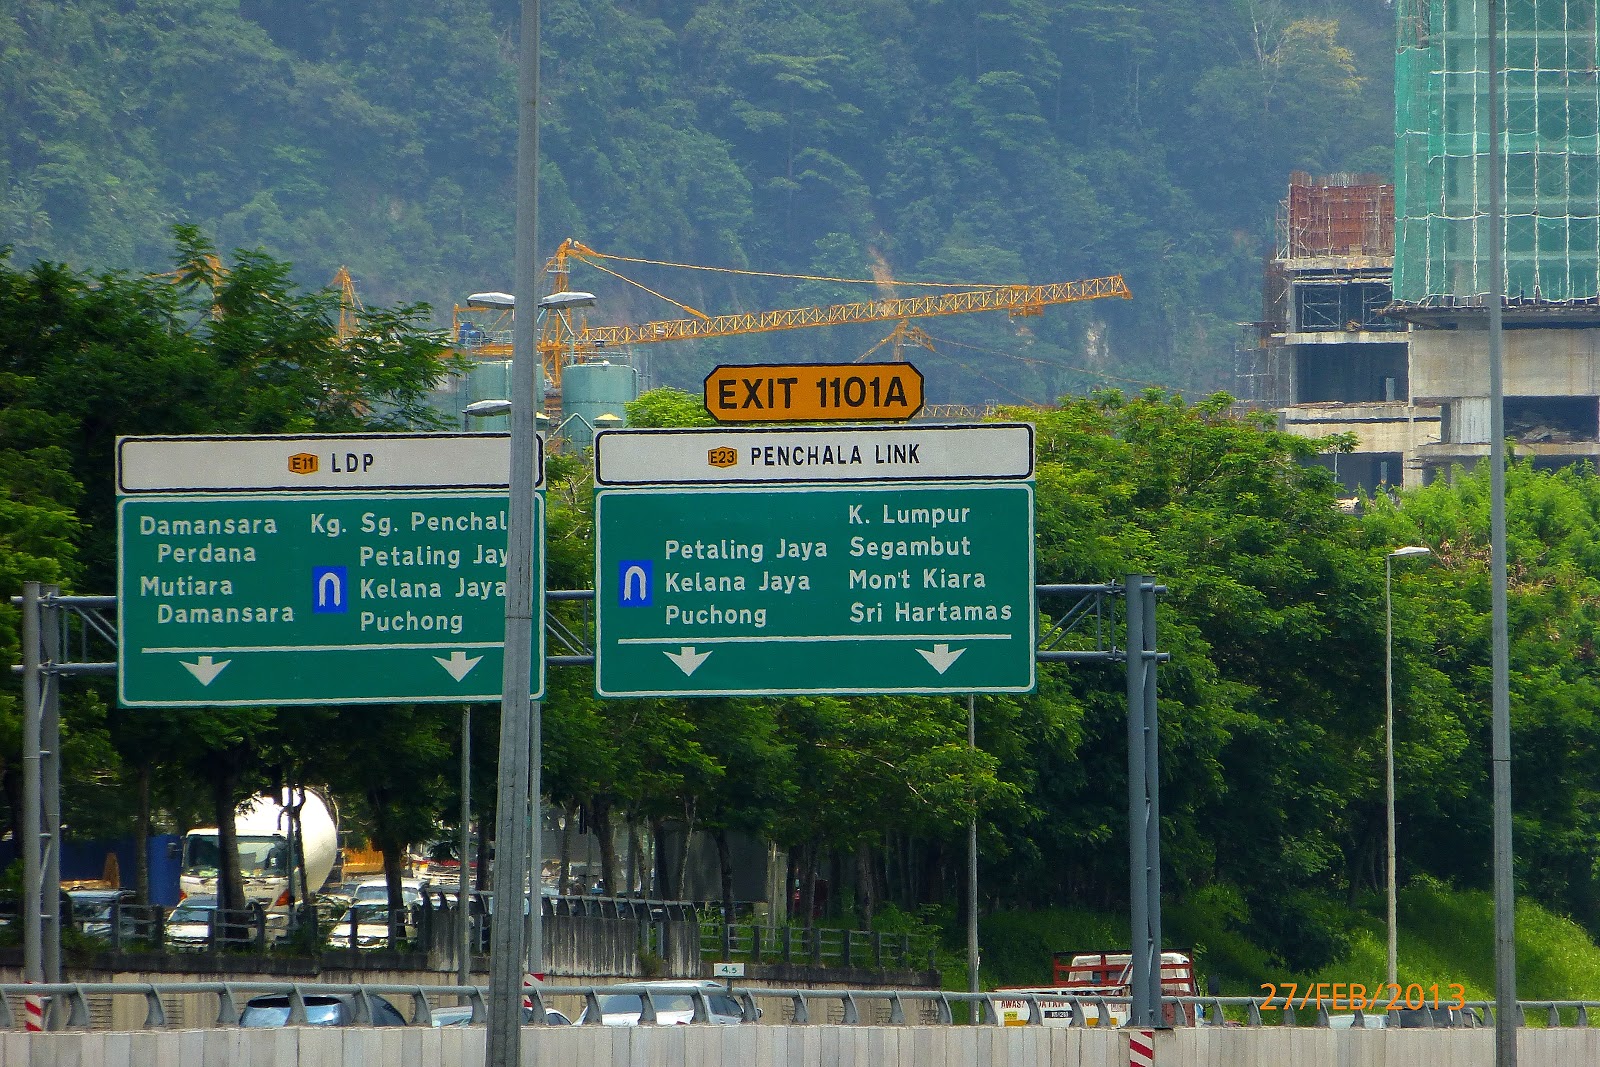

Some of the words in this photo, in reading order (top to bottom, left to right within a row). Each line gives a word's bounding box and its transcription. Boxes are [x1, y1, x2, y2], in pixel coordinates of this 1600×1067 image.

[719, 378, 798, 409] EXIT
[816, 376, 907, 407] 1101A
[292, 457, 314, 470] E11
[332, 454, 373, 472] LDP
[710, 450, 735, 465] E23
[752, 446, 861, 465] PENCHALA
[876, 444, 919, 463] LINK
[141, 516, 277, 535] Damansara
[312, 514, 346, 537] Kg.
[361, 513, 398, 536] Sg.
[412, 511, 506, 531] Penchal
[849, 505, 869, 524] K.
[884, 505, 970, 528] Lumpur
[159, 543, 255, 562] Perdana
[361, 546, 459, 568] Petaling
[473, 545, 507, 567] Jay
[666, 540, 763, 562] Petaling
[777, 539, 827, 560] Jaya
[850, 536, 970, 560] Segambut
[141, 576, 232, 596] Mutiara
[361, 579, 441, 598] Kelana
[456, 578, 507, 599] Jaya
[666, 573, 745, 592] Kelana
[759, 572, 810, 594] Jaya
[924, 568, 985, 588] Kiara
[158, 605, 293, 623] Damansara
[361, 612, 462, 633] Puchong
[666, 605, 766, 627] Puchong
[850, 602, 882, 622] Sri
[896, 602, 1011, 621] Hartamas
